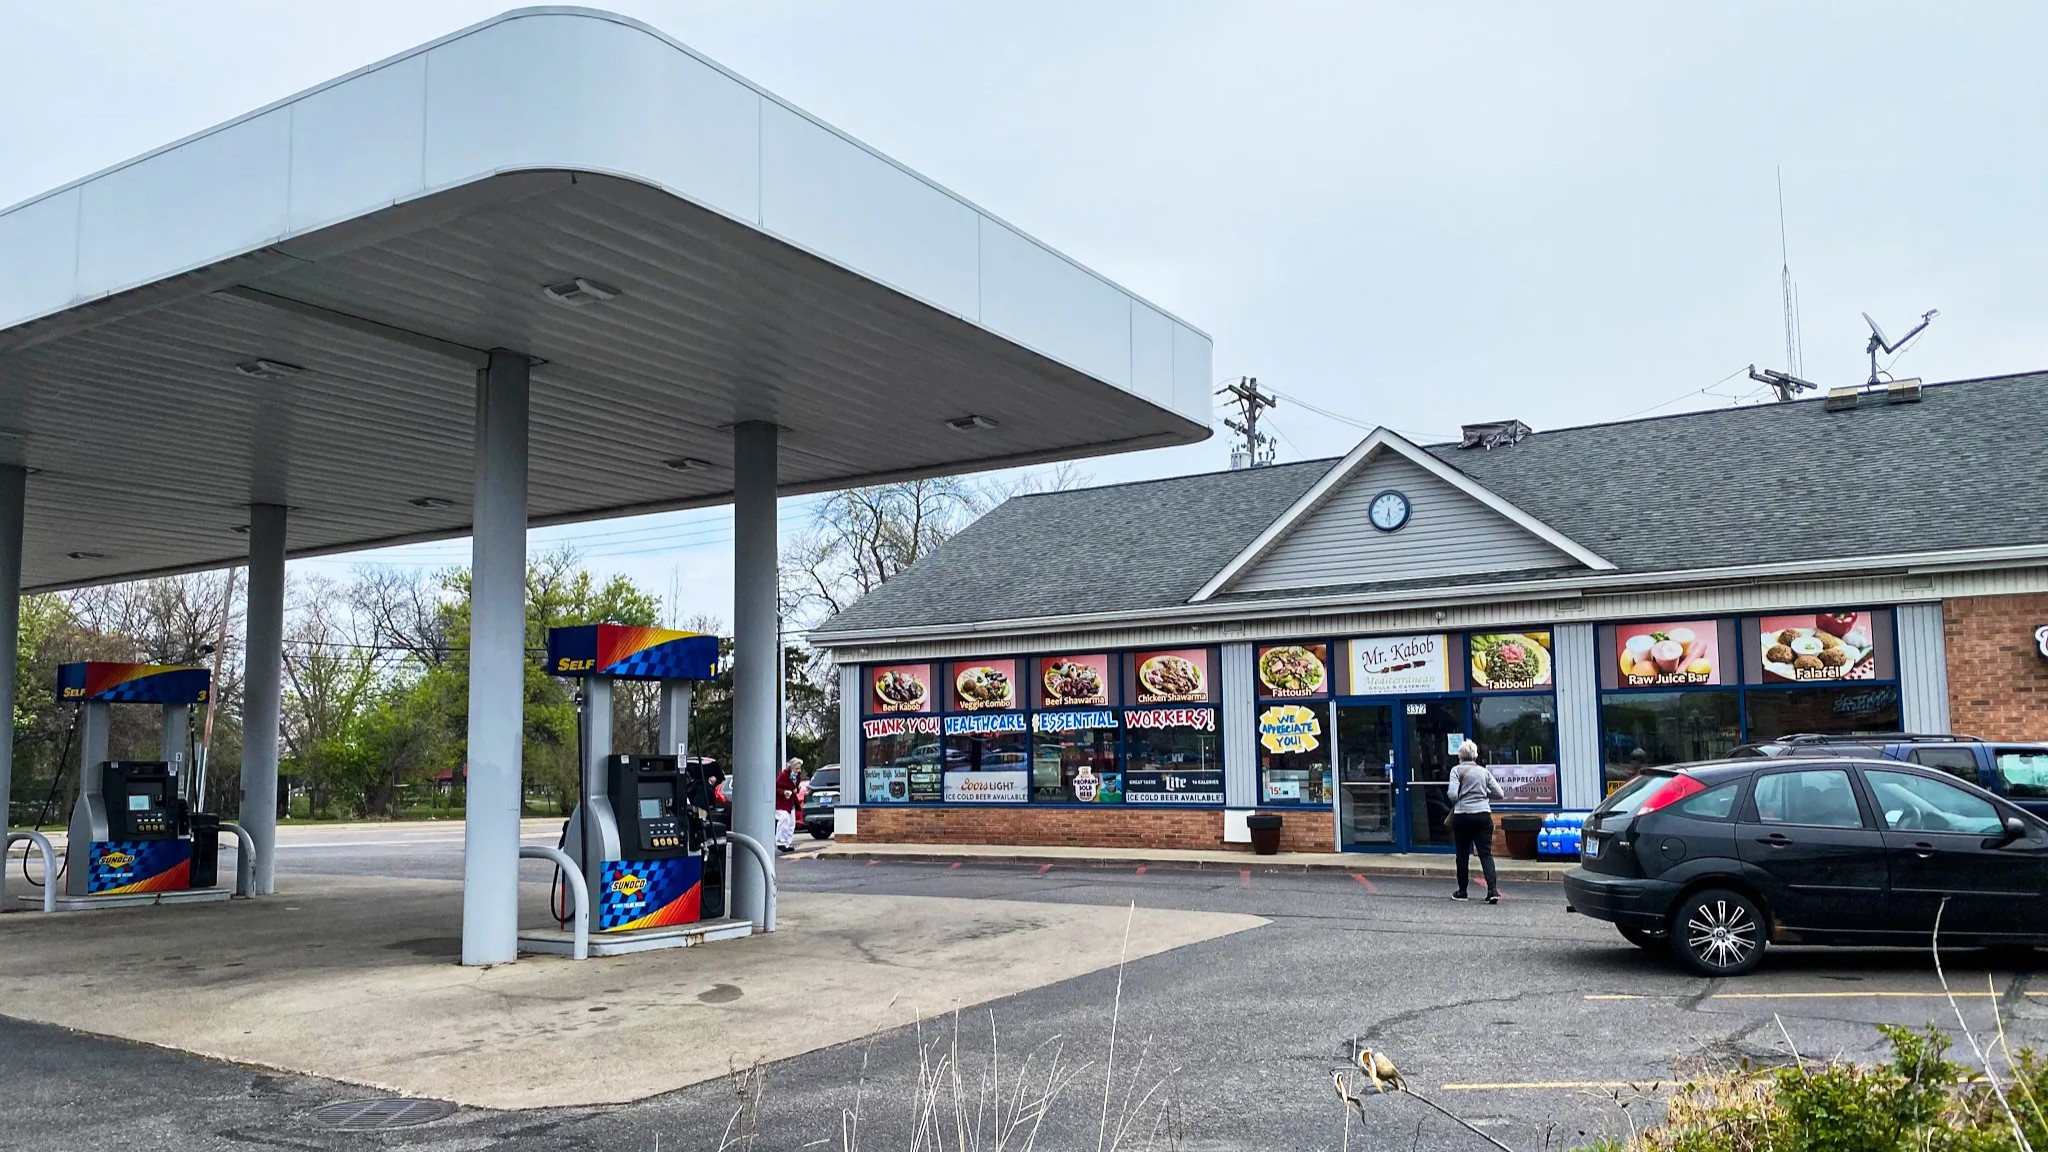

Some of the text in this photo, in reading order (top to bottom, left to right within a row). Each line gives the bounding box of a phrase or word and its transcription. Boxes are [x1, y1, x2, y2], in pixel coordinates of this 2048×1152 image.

[1362, 635, 1434, 665] Mr. Kabob
[710, 663, 716, 677] 1
[1796, 668, 1840, 679] Falafel
[1487, 678, 1534, 689] Tabbouli
[1629, 673, 1708, 684] Raw Juice Bar
[197, 690, 207, 700] 3
[1138, 692, 1208, 703] Chicken Shawarma
[1272, 687, 1312, 697] Fattoush
[960, 700, 1011, 711] Veggie Combo
[1045, 695, 1106, 706] Beef Shawarma
[882, 702, 920, 711] Beef Kabob
[1407, 704, 1425, 714] 3372
[864, 708, 1216, 738] THANK YOU! HEALTHCARE ESSENTIAL WORKERS!
[1277, 715, 1295, 723] WE
[1262, 722, 1313, 734] APPRECIATE
[1277, 735, 1302, 747] YOU!
[961, 778, 1014, 791] Coors LIGHT
[1165, 776, 1187, 791] Lite
[100, 856, 134, 864] SUNOCO
[612, 879, 646, 890] SUNOCO
